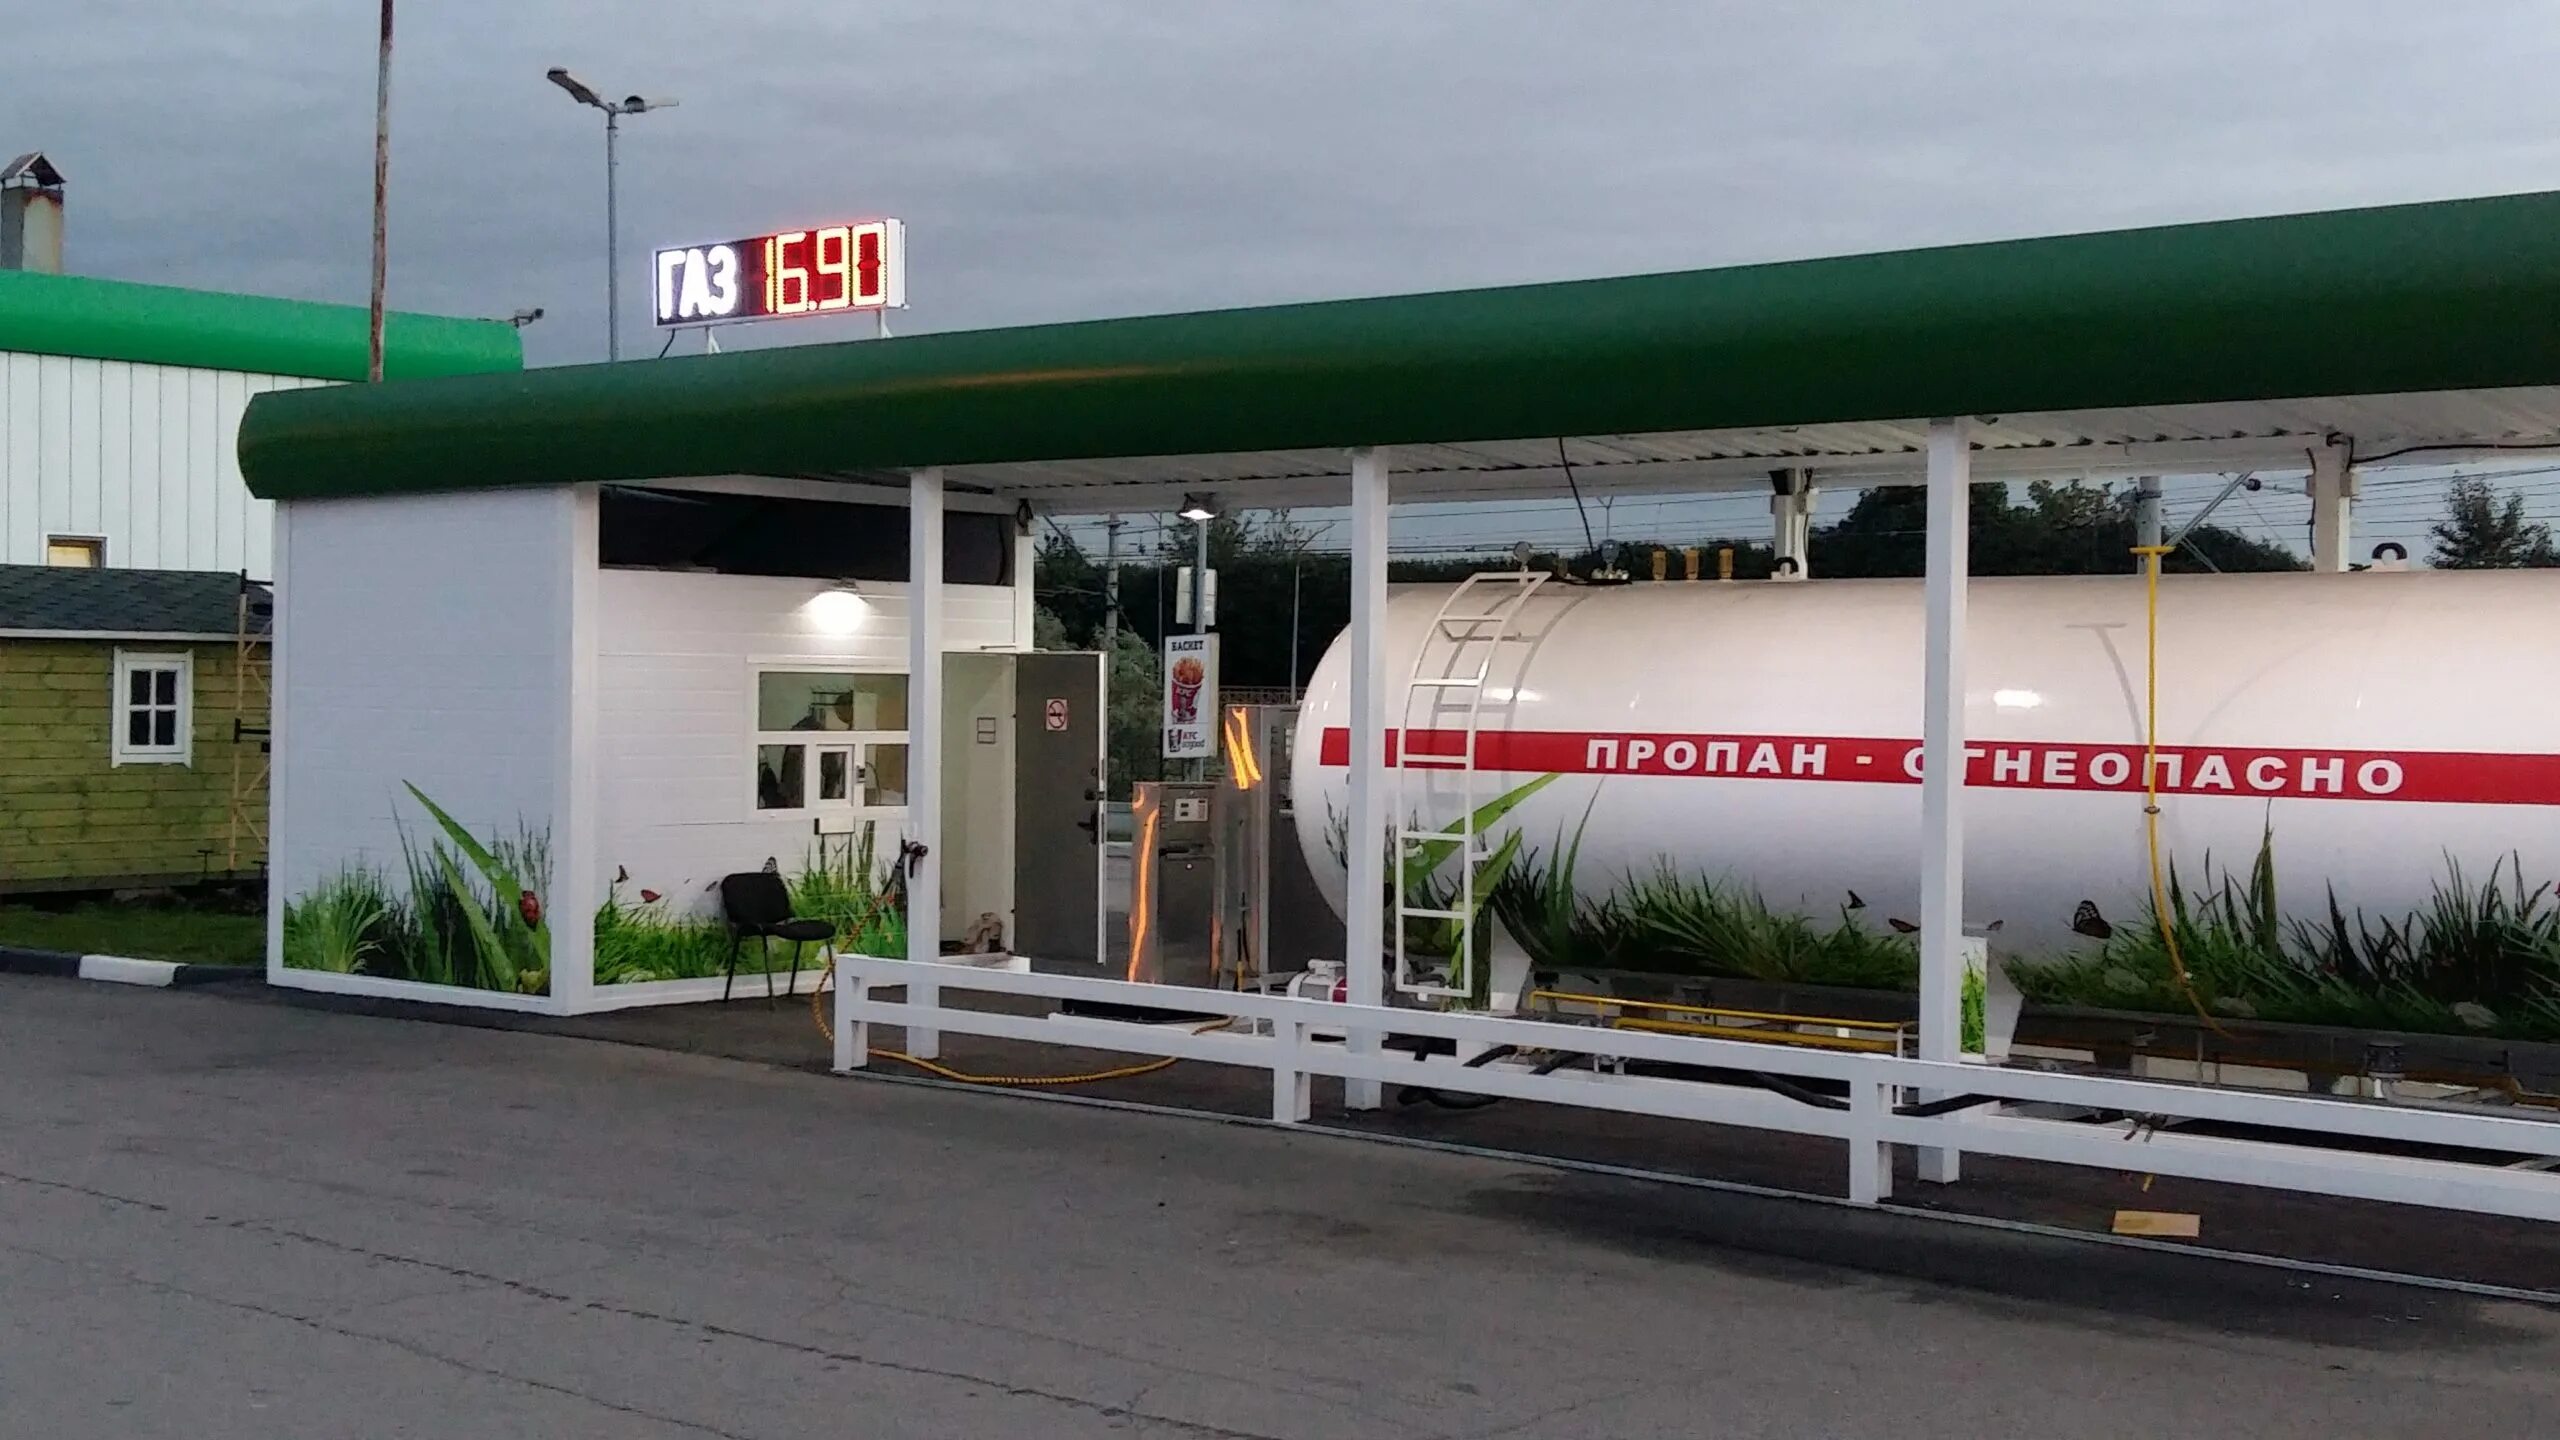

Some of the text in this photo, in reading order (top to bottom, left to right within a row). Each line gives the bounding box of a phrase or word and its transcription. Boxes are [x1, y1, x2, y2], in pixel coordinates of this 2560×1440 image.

[658, 245, 737, 319] ГАЗ
[764, 221, 886, 314] 16.90
[1172, 640, 1204, 651] БАСКЕТ
[1182, 731, 1198, 740] KFC
[1586, 738, 1827, 776] ПРОПАН
